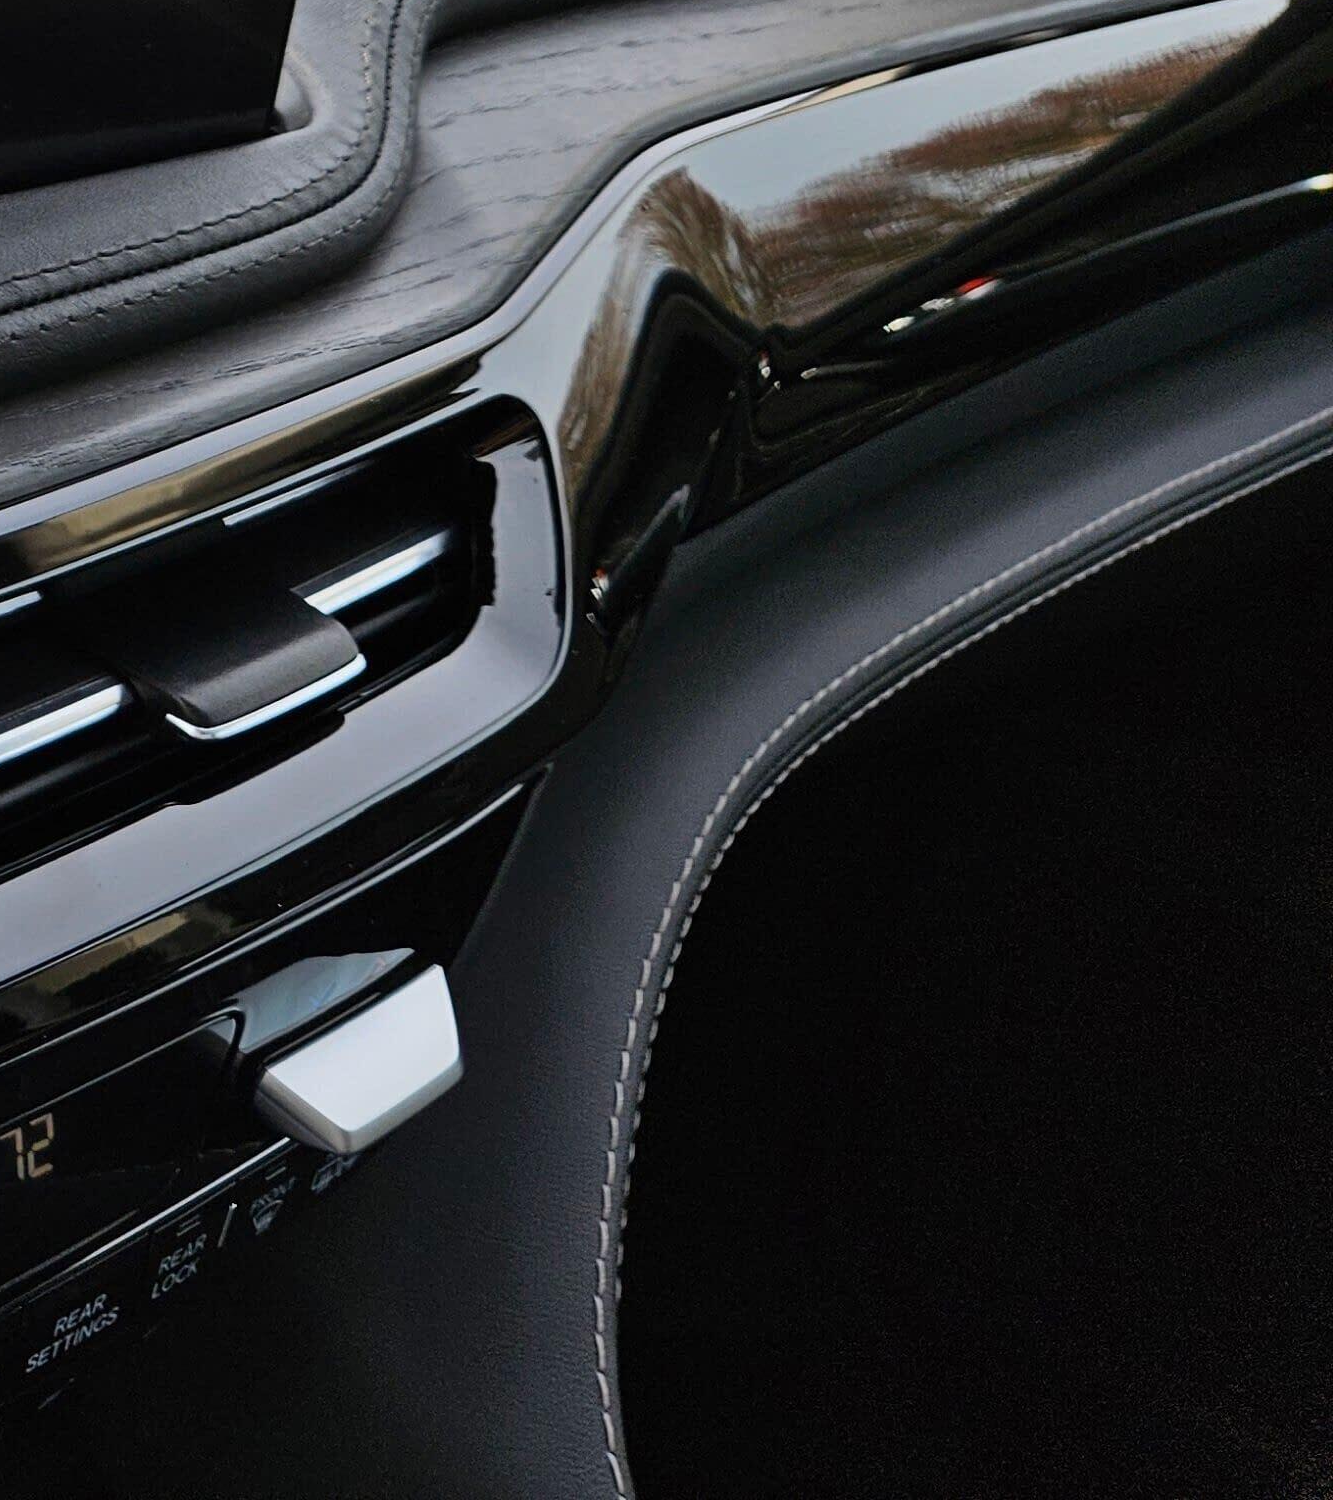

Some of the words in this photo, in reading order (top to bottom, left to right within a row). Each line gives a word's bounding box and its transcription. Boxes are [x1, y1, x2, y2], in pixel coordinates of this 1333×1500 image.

[0, 1113, 55, 1181] 72
[157, 1233, 208, 1276] REAR
[151, 1260, 200, 1299] LOCK
[53, 1293, 107, 1336] REAR
[25, 1306, 120, 1374] SETTINGS
